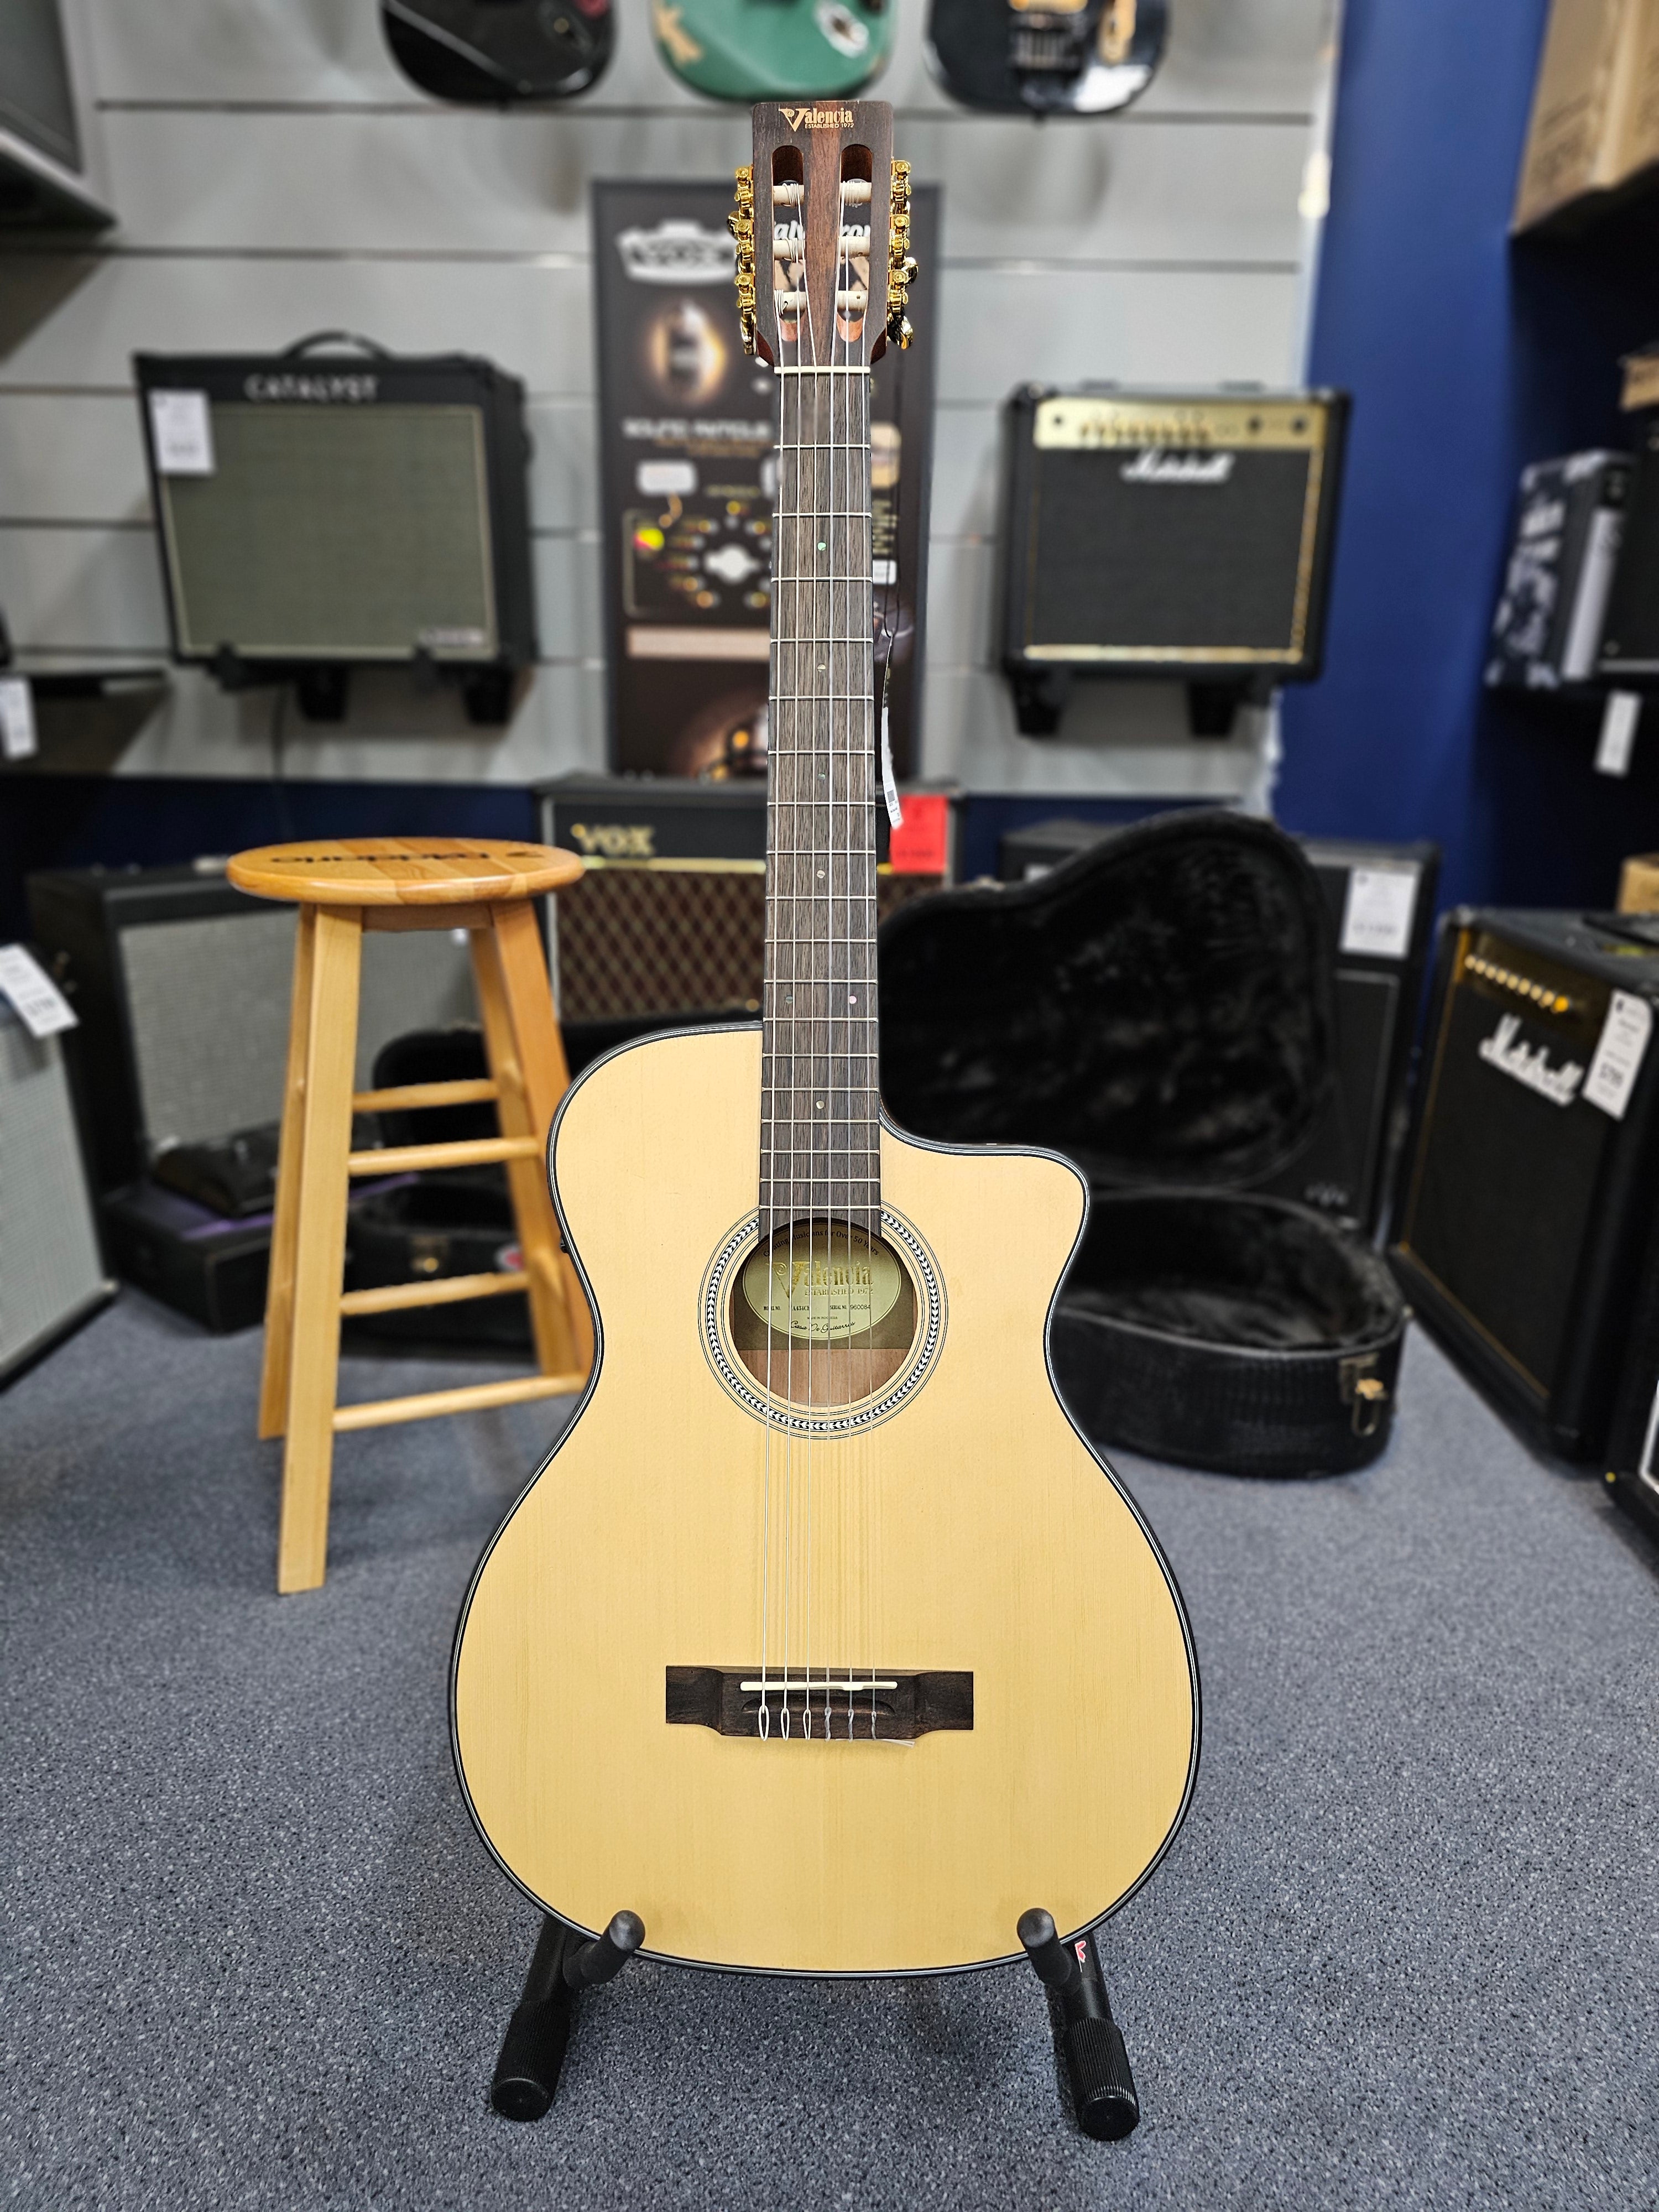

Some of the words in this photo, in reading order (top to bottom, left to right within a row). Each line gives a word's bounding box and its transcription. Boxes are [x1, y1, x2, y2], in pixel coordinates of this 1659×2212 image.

[779, 107, 853, 132] Valencia
[570, 823, 655, 856] VOX
[763, 1238, 790, 1257] Cating
[791, 1230, 823, 1240] Musicans
[765, 1260, 874, 1298] Valencia
